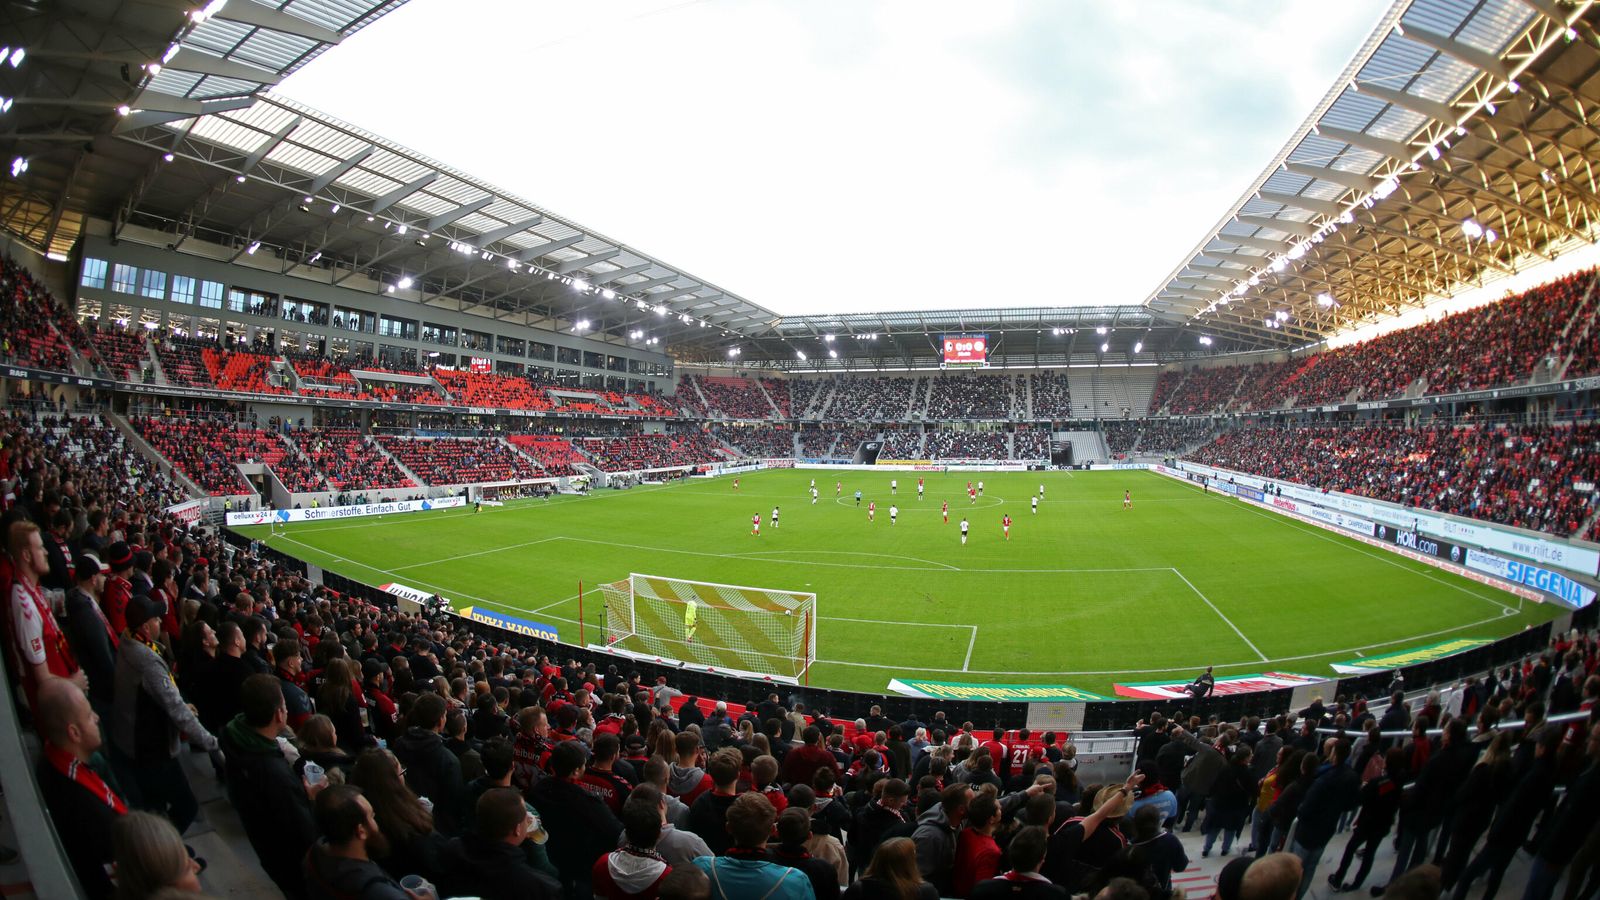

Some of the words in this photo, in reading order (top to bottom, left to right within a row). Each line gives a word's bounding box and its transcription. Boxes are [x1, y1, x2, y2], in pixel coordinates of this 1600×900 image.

[9, 369, 28, 378] RAFI
[365, 503, 396, 514] Einfach.
[398, 503, 411, 511] Gut
[1396, 530, 1438, 556] HORL.com
[1512, 541, 1563, 562] www.rilit.de
[1506, 561, 1582, 607] SIEGENIA
[1013, 749, 1028, 764] 21
